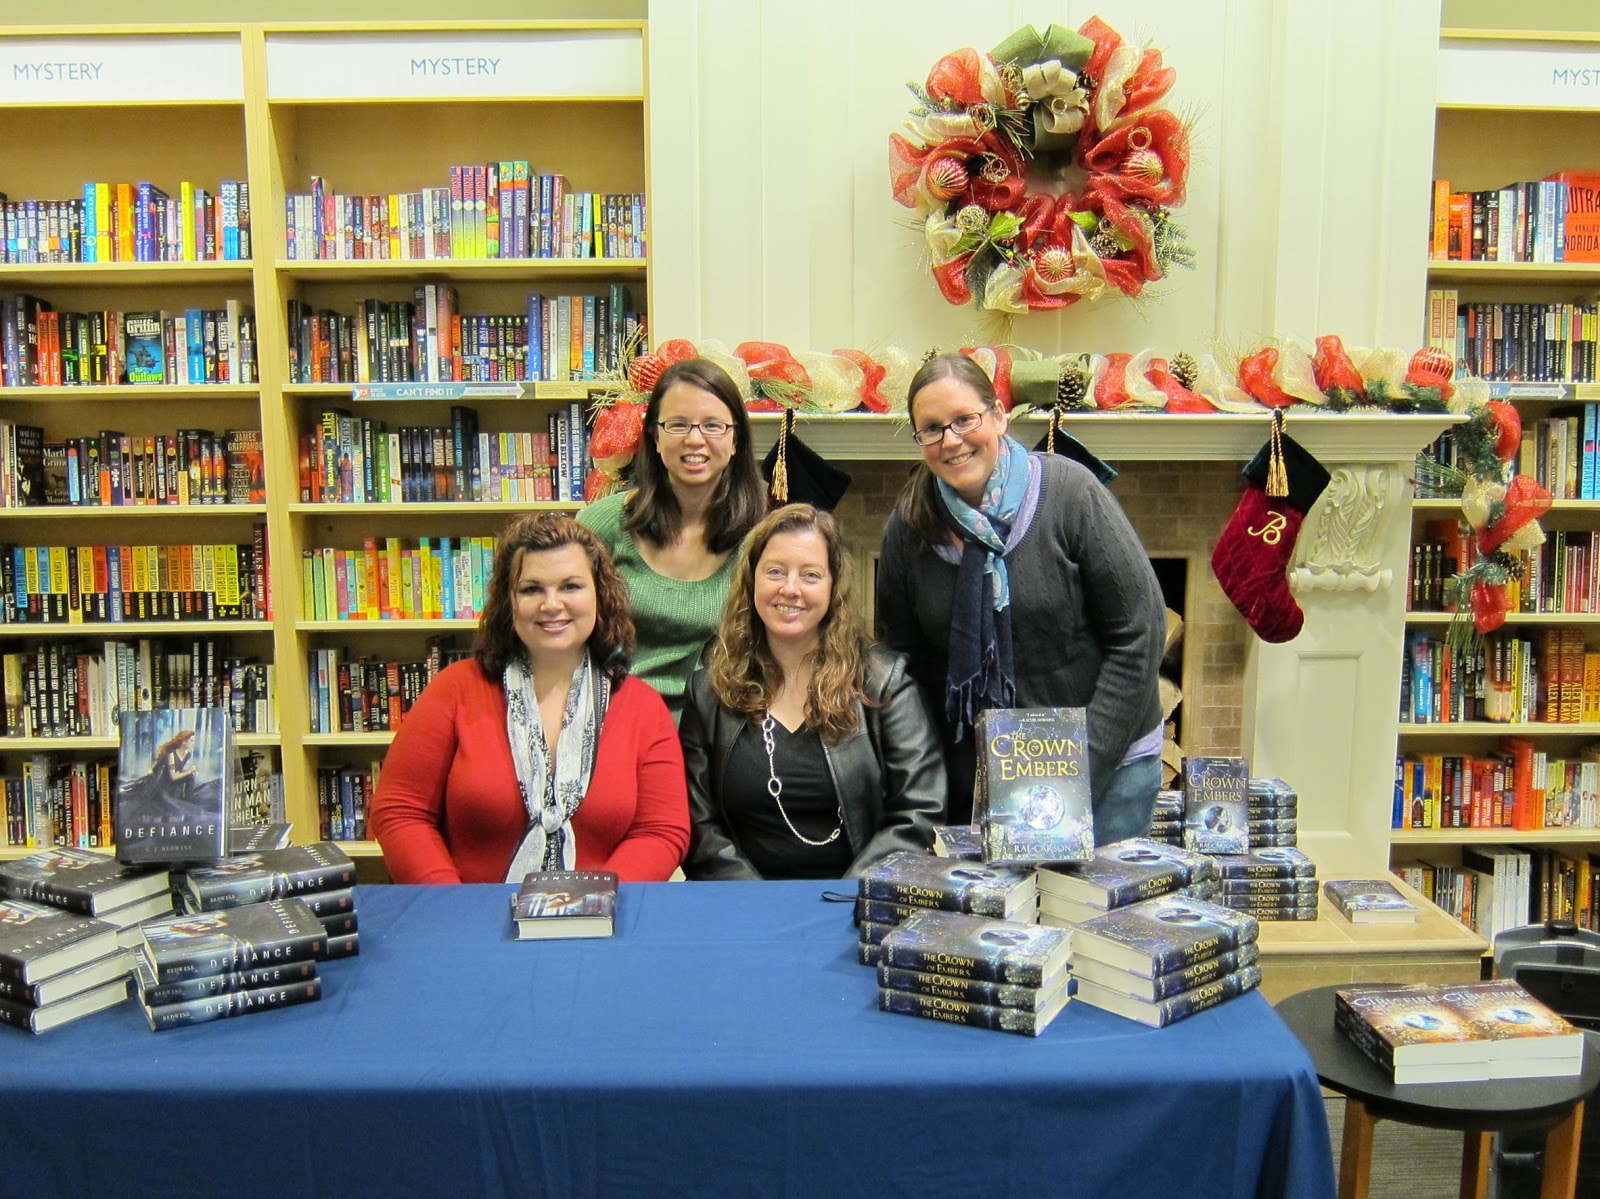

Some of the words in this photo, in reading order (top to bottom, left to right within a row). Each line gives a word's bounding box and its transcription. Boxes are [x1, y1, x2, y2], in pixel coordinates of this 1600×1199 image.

[13, 63, 104, 82] MYSTERY
[410, 58, 502, 77] MYSTERY
[1553, 69, 1600, 86] MYST
[221, 184, 230, 227] SKYJACK
[229, 184, 238, 227] SKYJACK
[585, 306, 593, 329] JOHN
[1432, 300, 1441, 318] POPULAR
[1446, 300, 1455, 318] POPULAR
[126, 319, 161, 334] Griffin
[559, 309, 567, 332] JOHN
[1432, 319, 1441, 338] CRIME
[1446, 319, 1455, 338] CRIME
[559, 333, 567, 354] HART
[585, 331, 593, 352] HART
[129, 372, 163, 382] Outlaws
[395, 388, 423, 396] CAN'T
[425, 388, 445, 396] FIND
[446, 388, 454, 396] IT
[1492, 387, 1500, 395] IT
[322, 413, 334, 441] HILL
[364, 421, 372, 430] THE
[559, 420, 567, 445] FOUR
[235, 433, 257, 442] JAMES
[342, 421, 350, 451] GONE
[364, 430, 372, 458] TREATMENT
[327, 448, 334, 460] MO
[354, 449, 363, 461] MO
[435, 439, 444, 466] CRASHERS
[365, 458, 372, 468] MO
[559, 446, 567, 478] BELOW
[231, 479, 249, 488] YOU
[354, 462, 363, 488] HAYDER
[1247, 511, 1287, 545] B
[254, 530, 264, 570] EXILES
[55, 561, 63, 572] JOHN
[83, 561, 91, 572] JOHN
[111, 562, 119, 571] JOHN
[132, 559, 145, 571] JOHN
[149, 559, 157, 570] JOHN
[206, 559, 214, 570] JOHN
[215, 561, 226, 576] JOHN
[227, 561, 238, 576] JOHN
[55, 573, 63, 592] GRISHAM
[83, 572, 91, 591] GRISHAM
[111, 571, 119, 589] GRISHAM
[132, 572, 145, 591] GRISHAM
[149, 570, 157, 591] GRISHAM
[206, 571, 214, 590] GRISHAM
[215, 577, 226, 603] GRISHAM
[227, 577, 238, 603] GRISHAM
[119, 646, 127, 667] DEREK
[431, 647, 439, 674] REGIN
[29, 671, 37, 679] THE
[37, 654, 46, 679] SKELETON
[50, 653, 59, 679] SKELETON
[37, 679, 46, 691] BOX
[50, 679, 59, 691] BOX
[119, 667, 127, 685] HAAS
[339, 672, 347, 690] HILL
[1584, 668, 1592, 687] KAVA
[29, 679, 37, 697] HANGING
[1547, 682, 1560, 701] ALEX
[1560, 682, 1572, 701] ALEX
[1571, 682, 1583, 701] ALEX
[29, 698, 37, 708] TREE
[67, 695, 75, 706] LAKE
[1547, 702, 1560, 722] KAVA
[1560, 702, 1572, 722] KAVA
[1571, 702, 1583, 722] KAVA
[1010, 731, 1026, 740] THE
[990, 735, 1084, 761] CROWN
[999, 759, 1079, 781] EMBERS
[1188, 773, 1247, 791] CROWN
[64, 780, 72, 809] PATRICIA
[246, 789, 271, 806] MAN
[1193, 789, 1243, 803] EMBERS
[125, 824, 215, 839] DEFIANCE
[1014, 844, 1029, 853] RAE
[1031, 844, 1072, 853] CARSON
[248, 877, 324, 898] DEFIANCE
[896, 885, 909, 893] THE
[909, 885, 944, 899] CROWN
[1139, 882, 1148, 891] THE
[1147, 876, 1173, 889] CROWN
[16, 887, 68, 905] DEFIANCE
[908, 895, 940, 908] EMBERS
[1258, 895, 1280, 903] CROWN
[896, 907, 910, 916] THE
[1184, 946, 1194, 956] THE
[1193, 937, 1219, 951] CROWN
[166, 965, 195, 975] REDWINE
[210, 946, 293, 968] DEFIANCE
[923, 953, 937, 961] THE
[937, 953, 975, 968] CROWN
[936, 963, 971, 977] EMBERS
[1184, 970, 1194, 980] THE
[1193, 960, 1219, 976] CROWN
[198, 970, 281, 991] DEFIANCE
[917, 975, 932, 983] THE
[931, 974, 969, 990] CROWN
[931, 985, 965, 999] EMBERS
[1190, 994, 1200, 1003] THE
[1198, 984, 1224, 999] CROWN
[162, 1011, 191, 1021] REDWINE
[205, 991, 287, 1013] DEFIANCE
[918, 998, 933, 1006] THE
[933, 998, 970, 1014] CROWN
[932, 1009, 967, 1024] EMBERS
